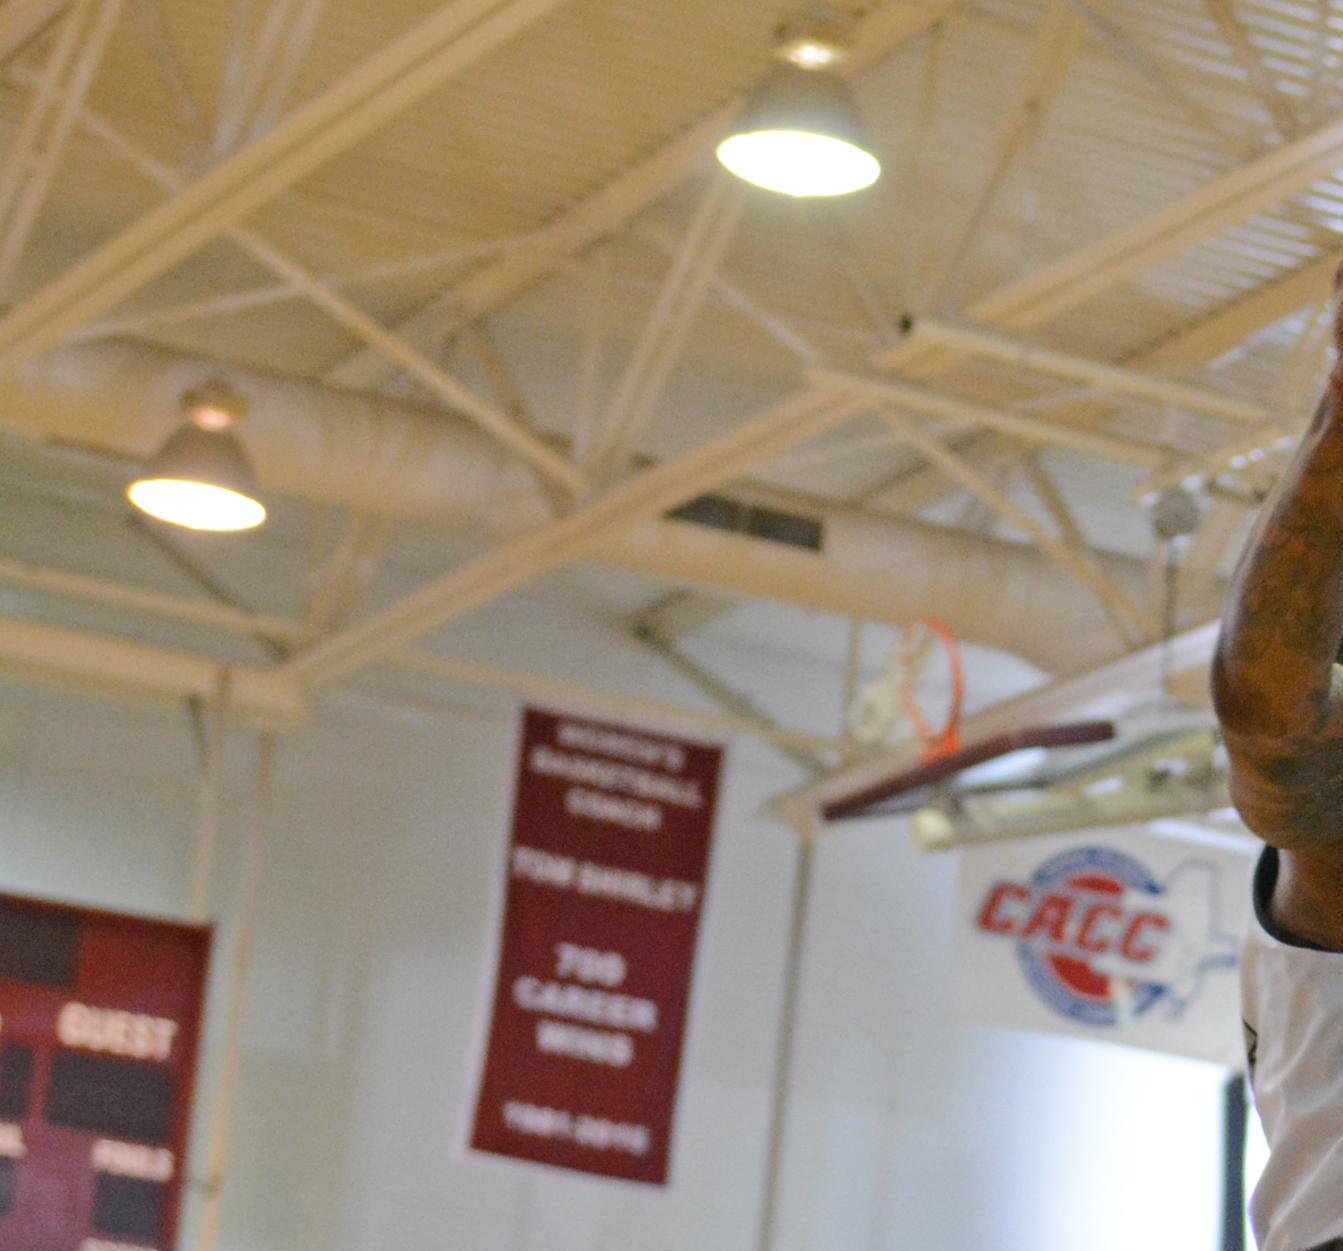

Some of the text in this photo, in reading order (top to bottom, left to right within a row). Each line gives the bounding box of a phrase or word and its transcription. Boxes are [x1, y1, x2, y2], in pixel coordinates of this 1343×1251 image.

[976, 880, 1172, 963] CACC
[57, 1000, 179, 1063] GUEST
[512, 975, 661, 1034] CAREER
[535, 1020, 635, 1068] WINS
